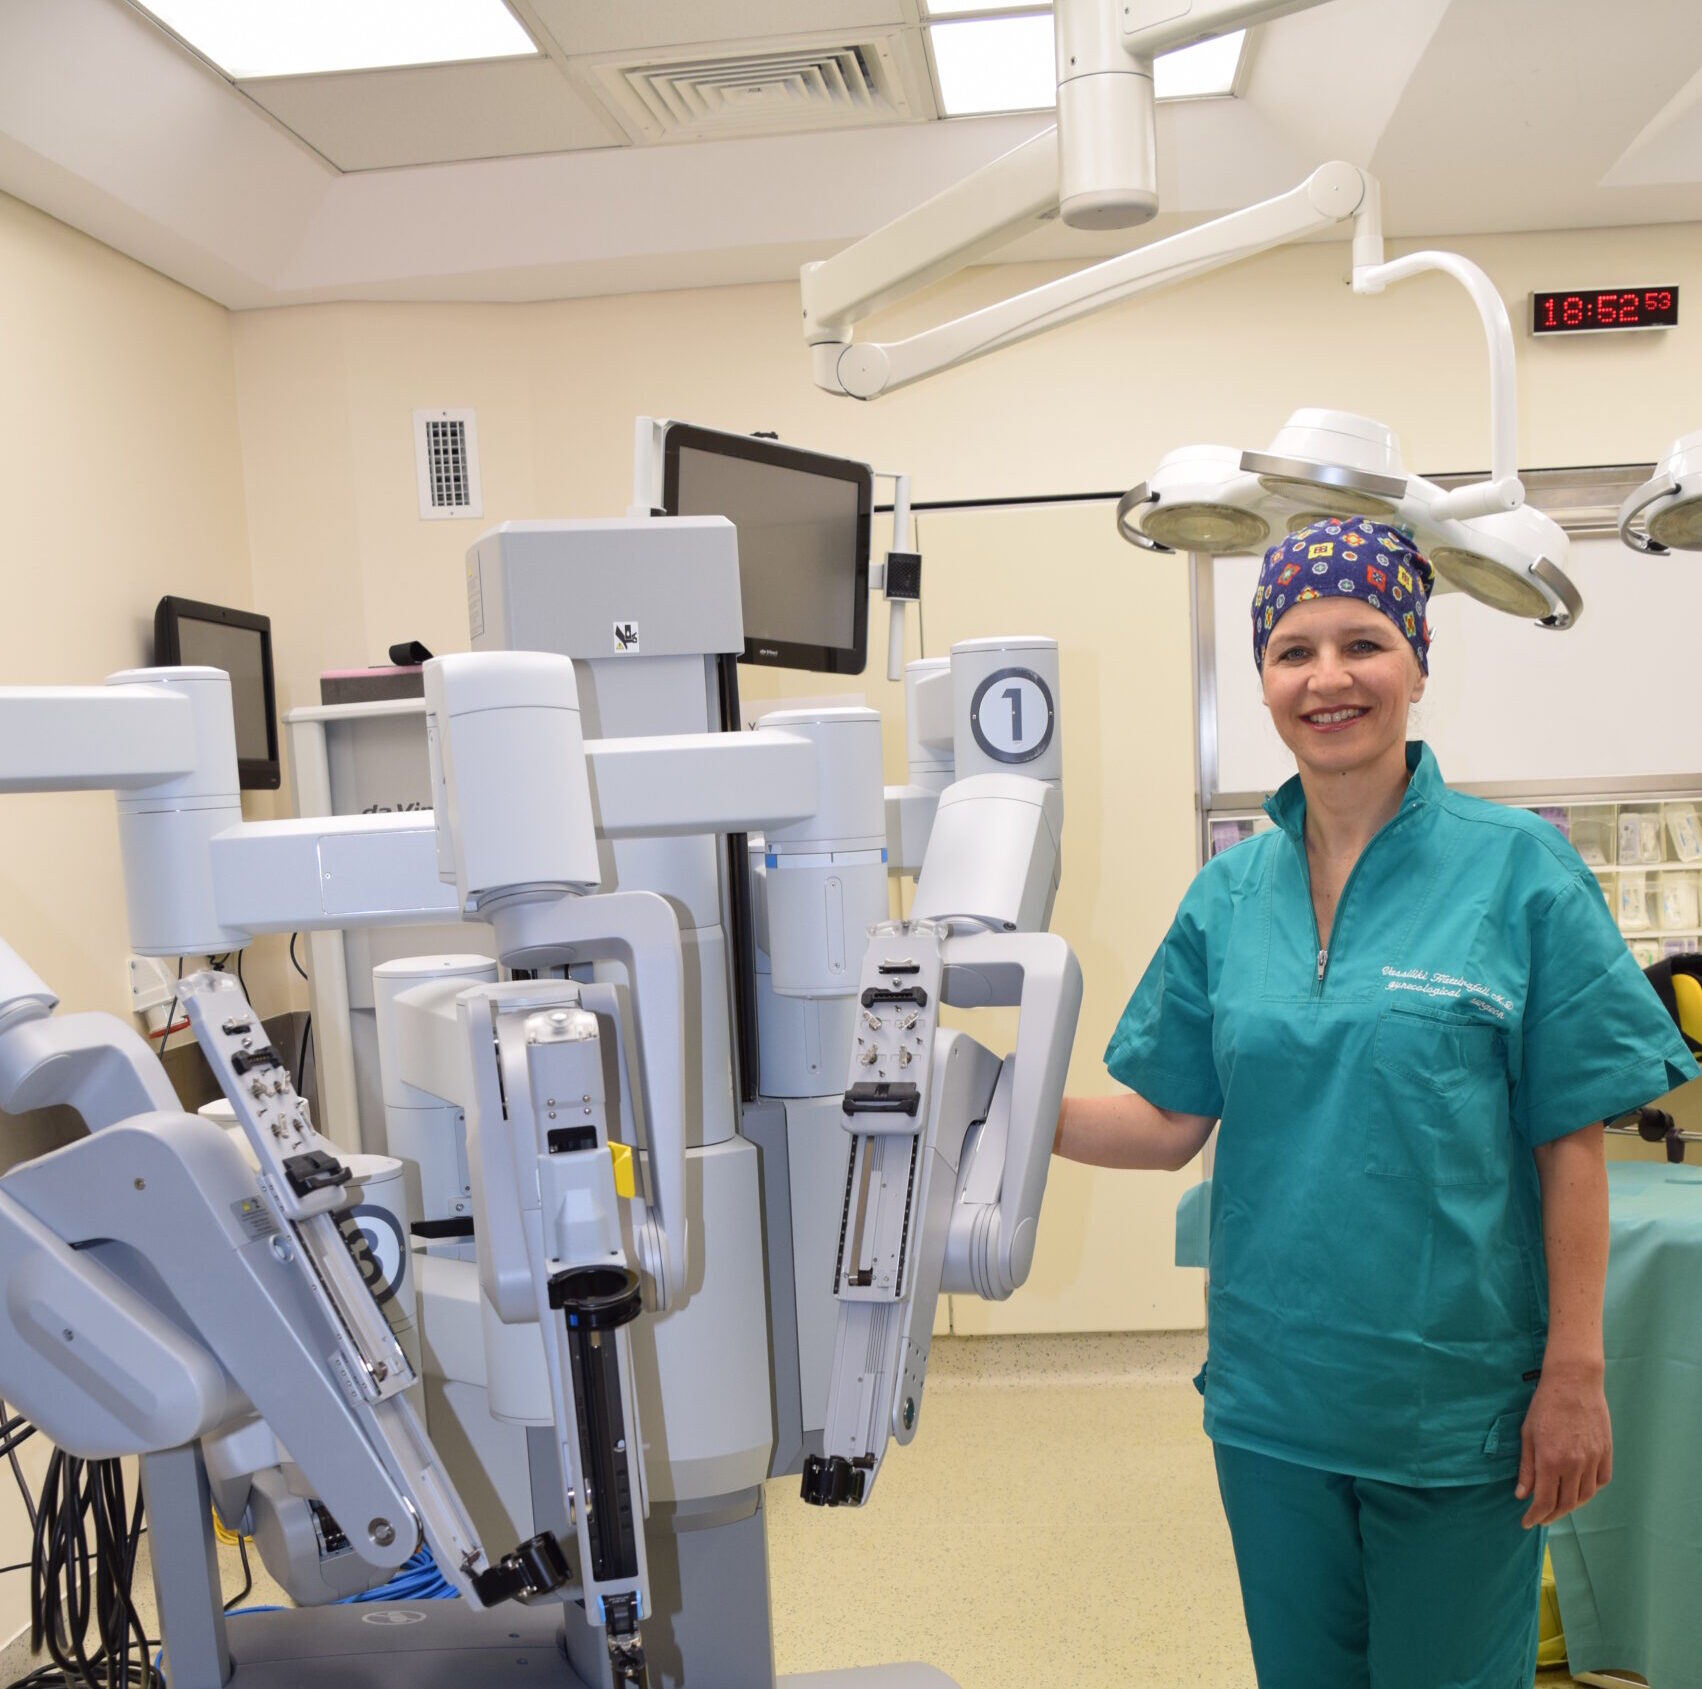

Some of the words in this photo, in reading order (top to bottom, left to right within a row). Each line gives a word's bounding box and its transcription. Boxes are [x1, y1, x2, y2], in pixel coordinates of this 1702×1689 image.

[1545, 294, 1638, 325] 18:52
[1645, 292, 1671, 310] 53
[1001, 688, 1023, 741] 1
[1470, 998, 1504, 1019] surgeon
[348, 1228, 384, 1286] 3
